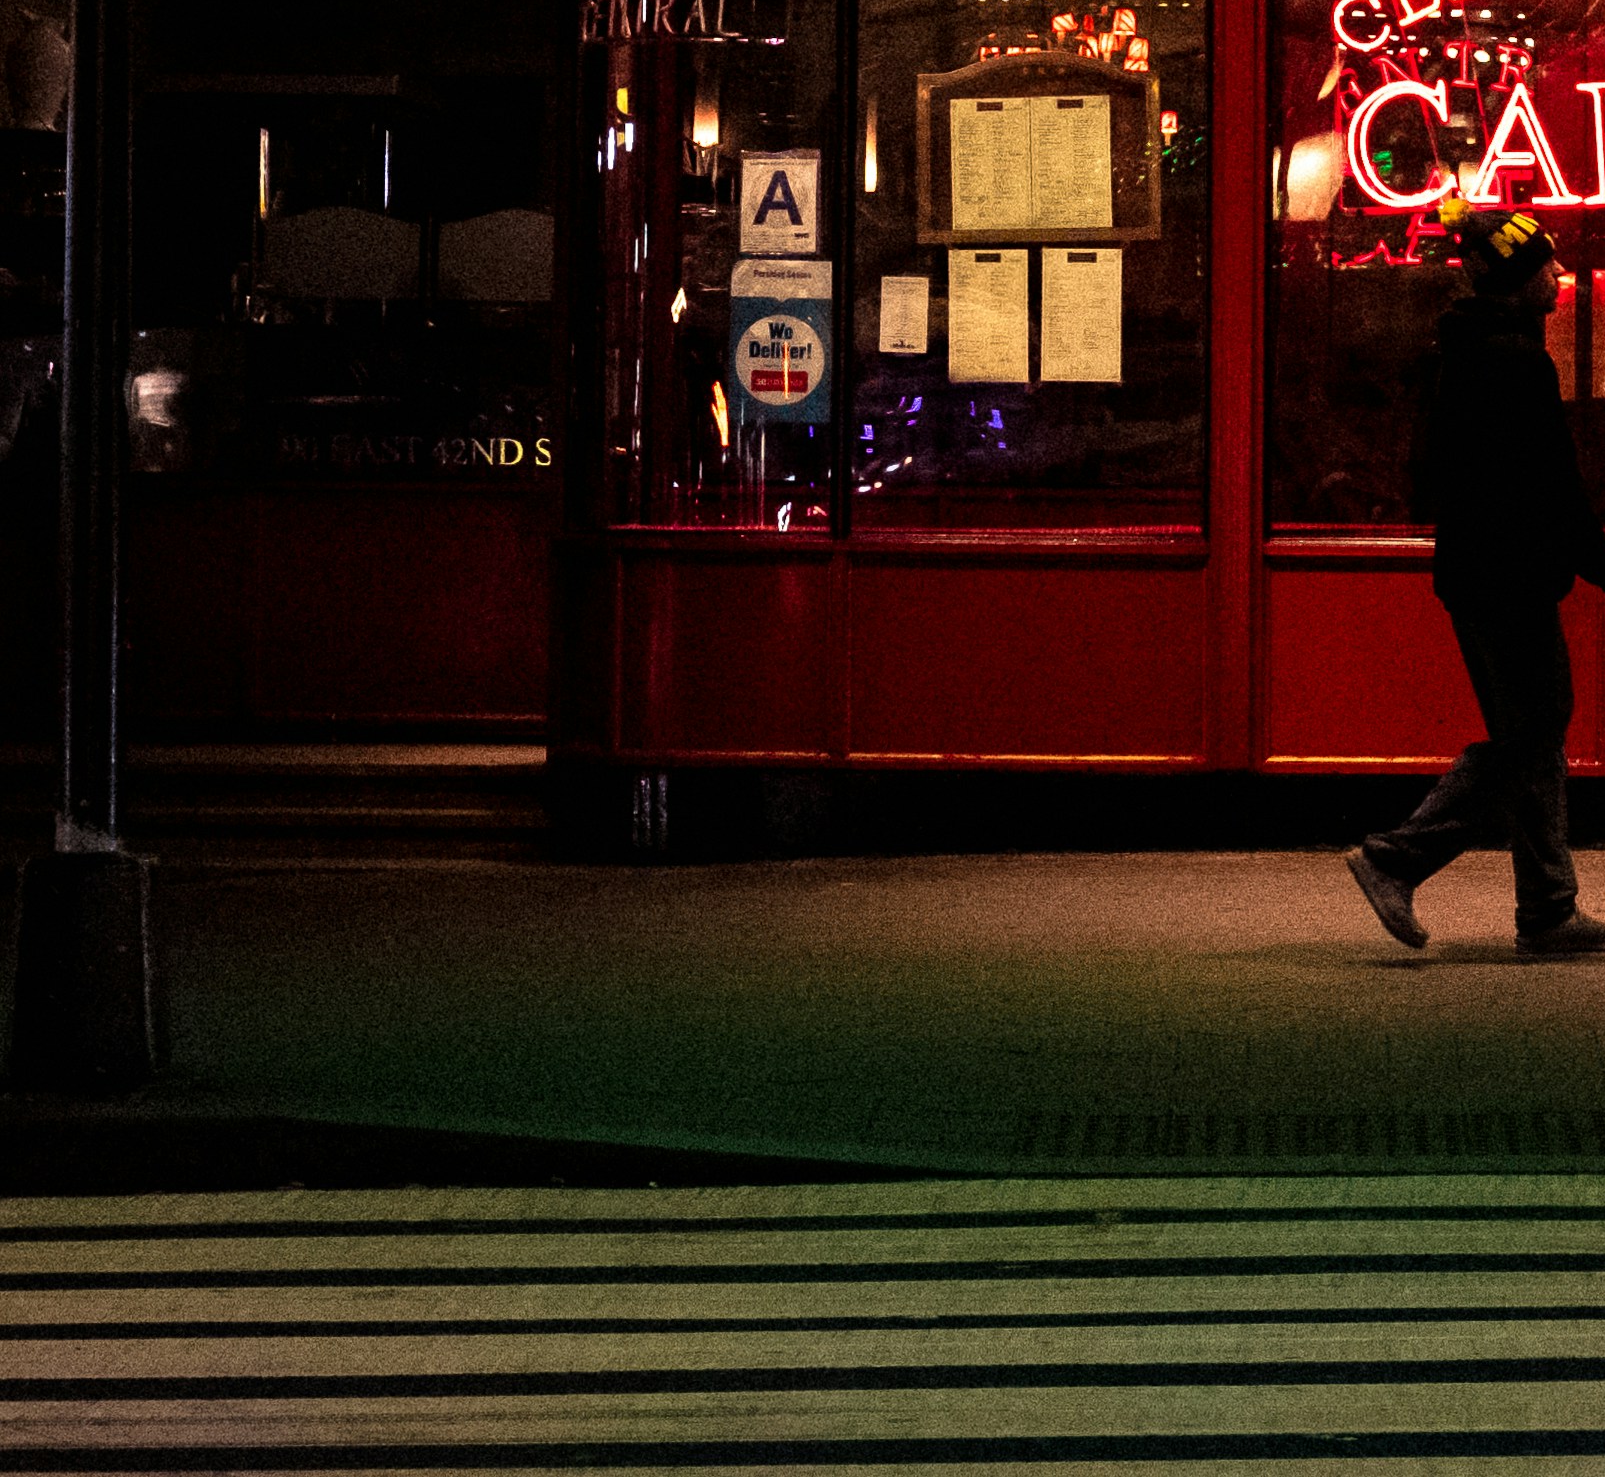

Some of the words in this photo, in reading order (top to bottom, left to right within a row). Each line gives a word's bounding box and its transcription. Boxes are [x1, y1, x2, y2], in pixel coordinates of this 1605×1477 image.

[753, 170, 803, 225] A
[432, 436, 524, 465] 42ND
[535, 437, 552, 465] S
